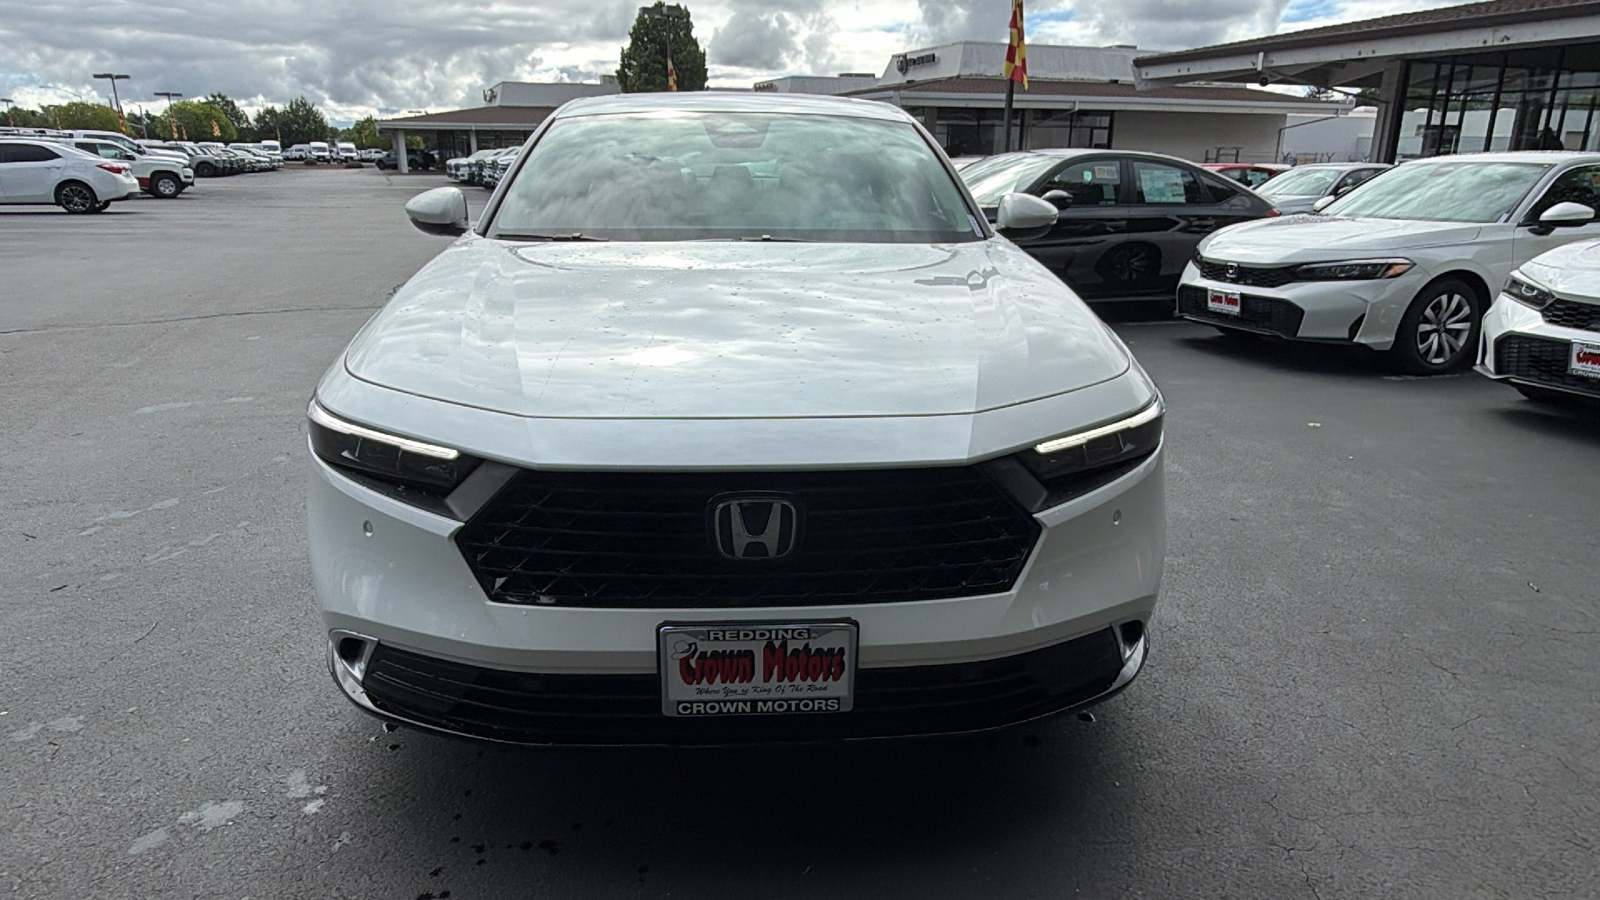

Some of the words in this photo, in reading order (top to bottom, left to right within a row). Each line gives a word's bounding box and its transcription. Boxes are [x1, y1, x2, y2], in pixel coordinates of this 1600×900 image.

[709, 629, 809, 641] REDDING
[679, 642, 755, 685] Crown
[763, 640, 846, 683] Motors
[695, 687, 720, 695] Where
[722, 686, 749, 697] You're
[752, 686, 772, 695] King
[775, 686, 786, 694] Of
[678, 701, 751, 714] CROWN
[757, 699, 839, 713] MOTORS
